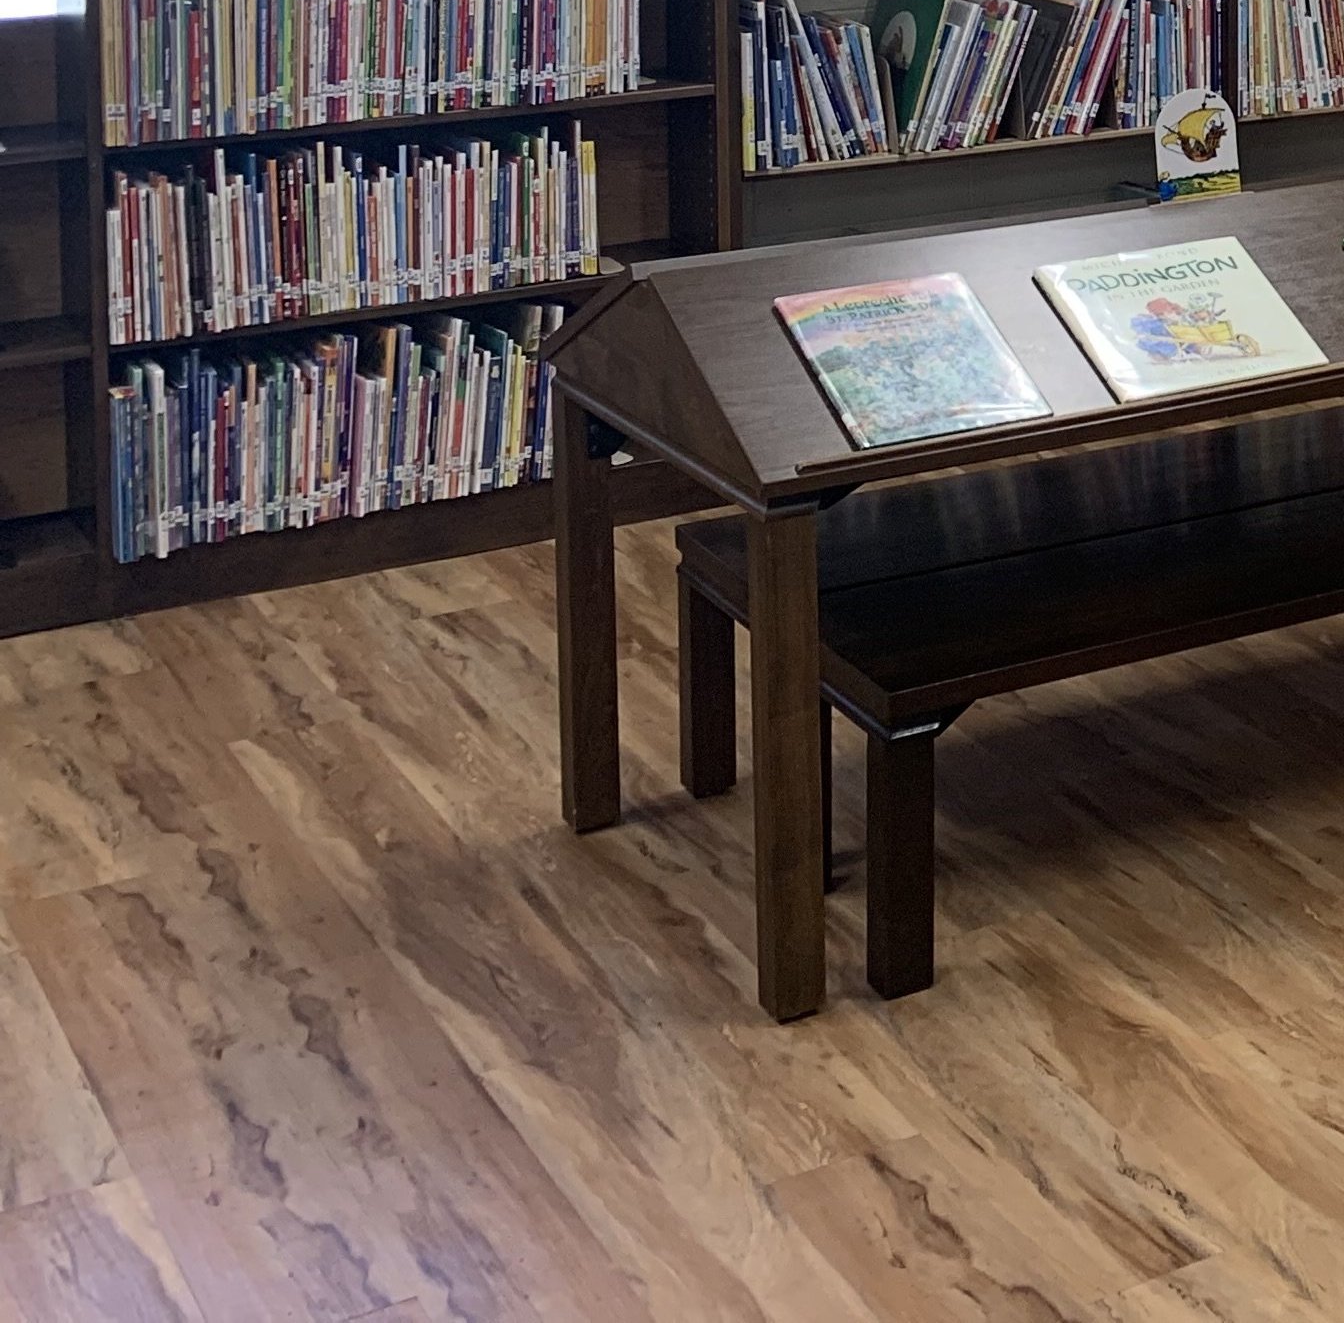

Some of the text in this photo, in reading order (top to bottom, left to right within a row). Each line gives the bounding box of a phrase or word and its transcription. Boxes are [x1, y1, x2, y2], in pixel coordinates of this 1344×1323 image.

[1066, 255, 1239, 295] PADDINGTON
[1106, 277, 1221, 302] IN THE GARDEN
